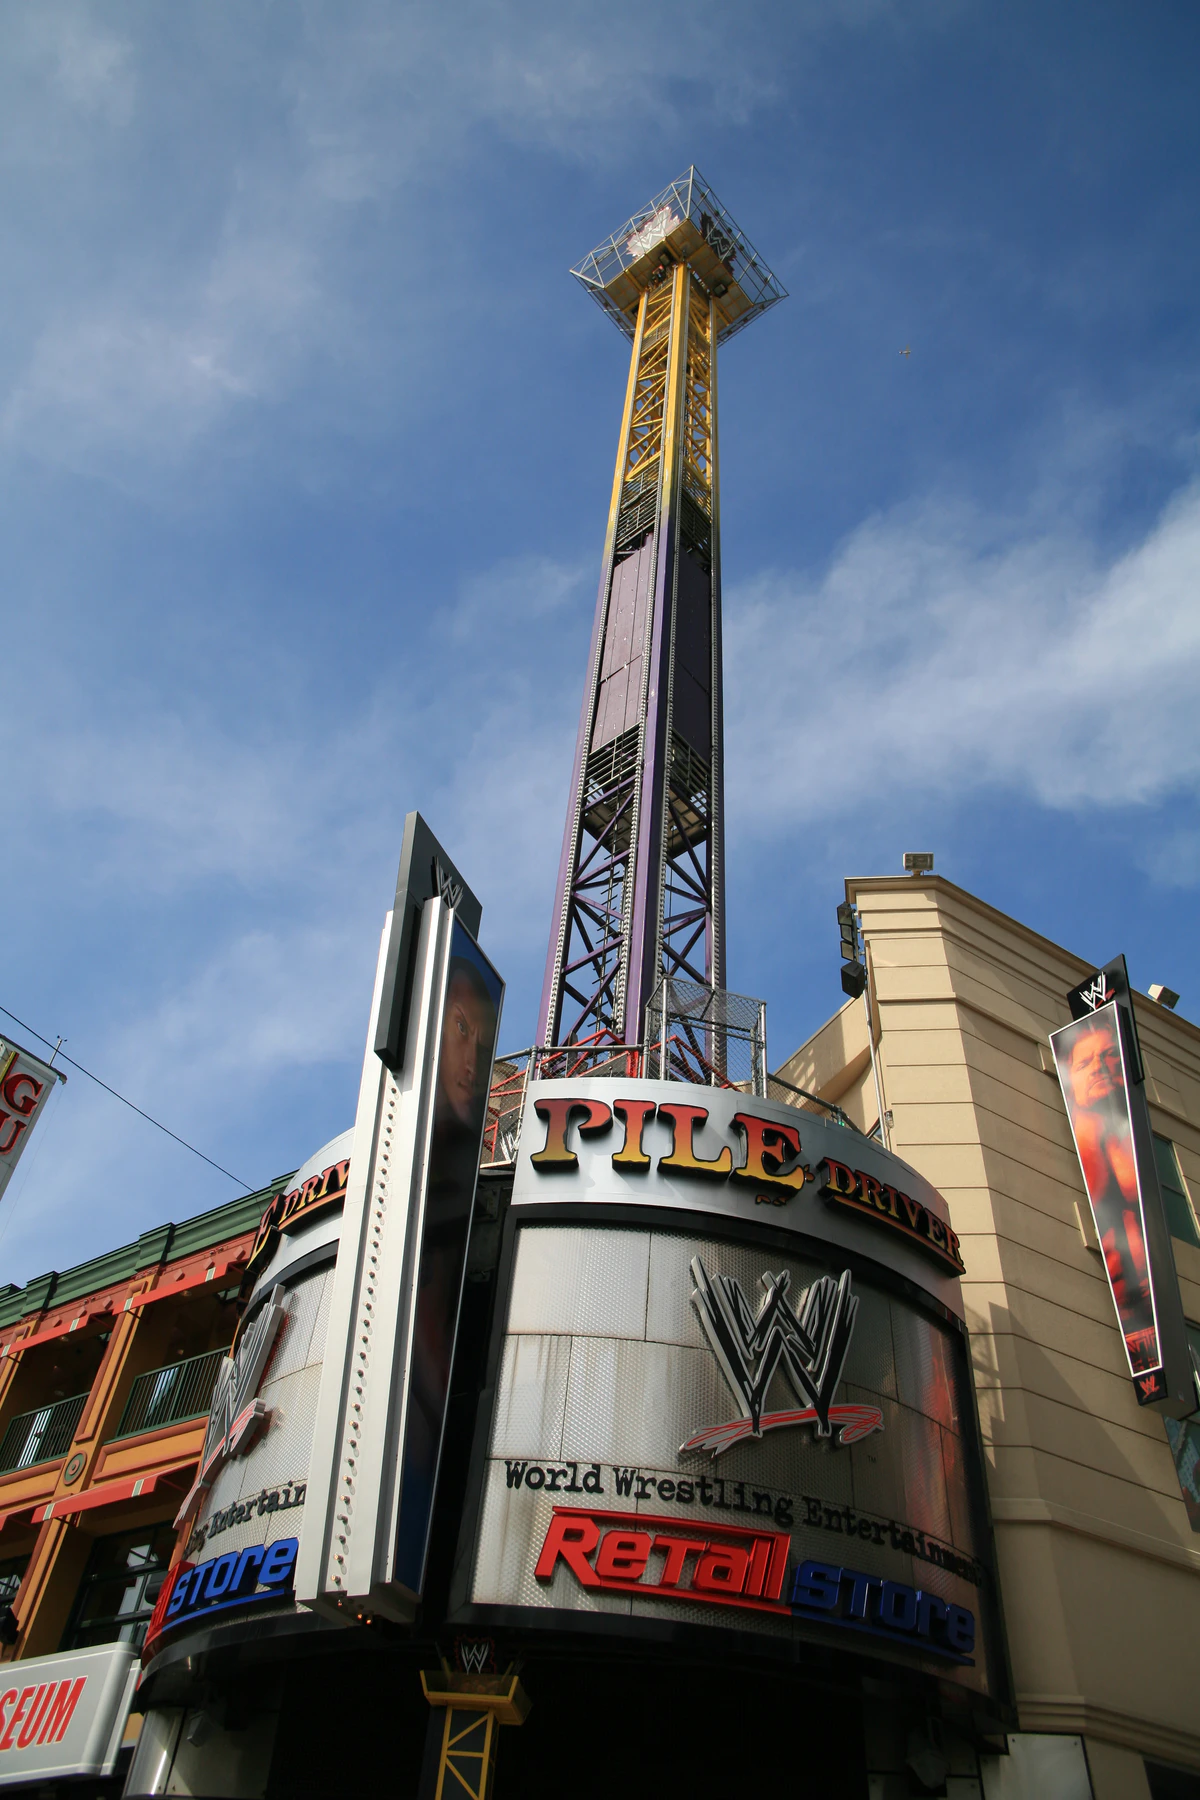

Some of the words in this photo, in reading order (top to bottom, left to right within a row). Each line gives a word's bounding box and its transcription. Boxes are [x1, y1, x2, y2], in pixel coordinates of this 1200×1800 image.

[530, 1098, 806, 1194] PILE
[817, 1157, 964, 1267] DRIVER
[505, 1460, 604, 1494] World
[613, 1466, 794, 1528] Wrestling
[803, 1496, 982, 1587] Entertainment
